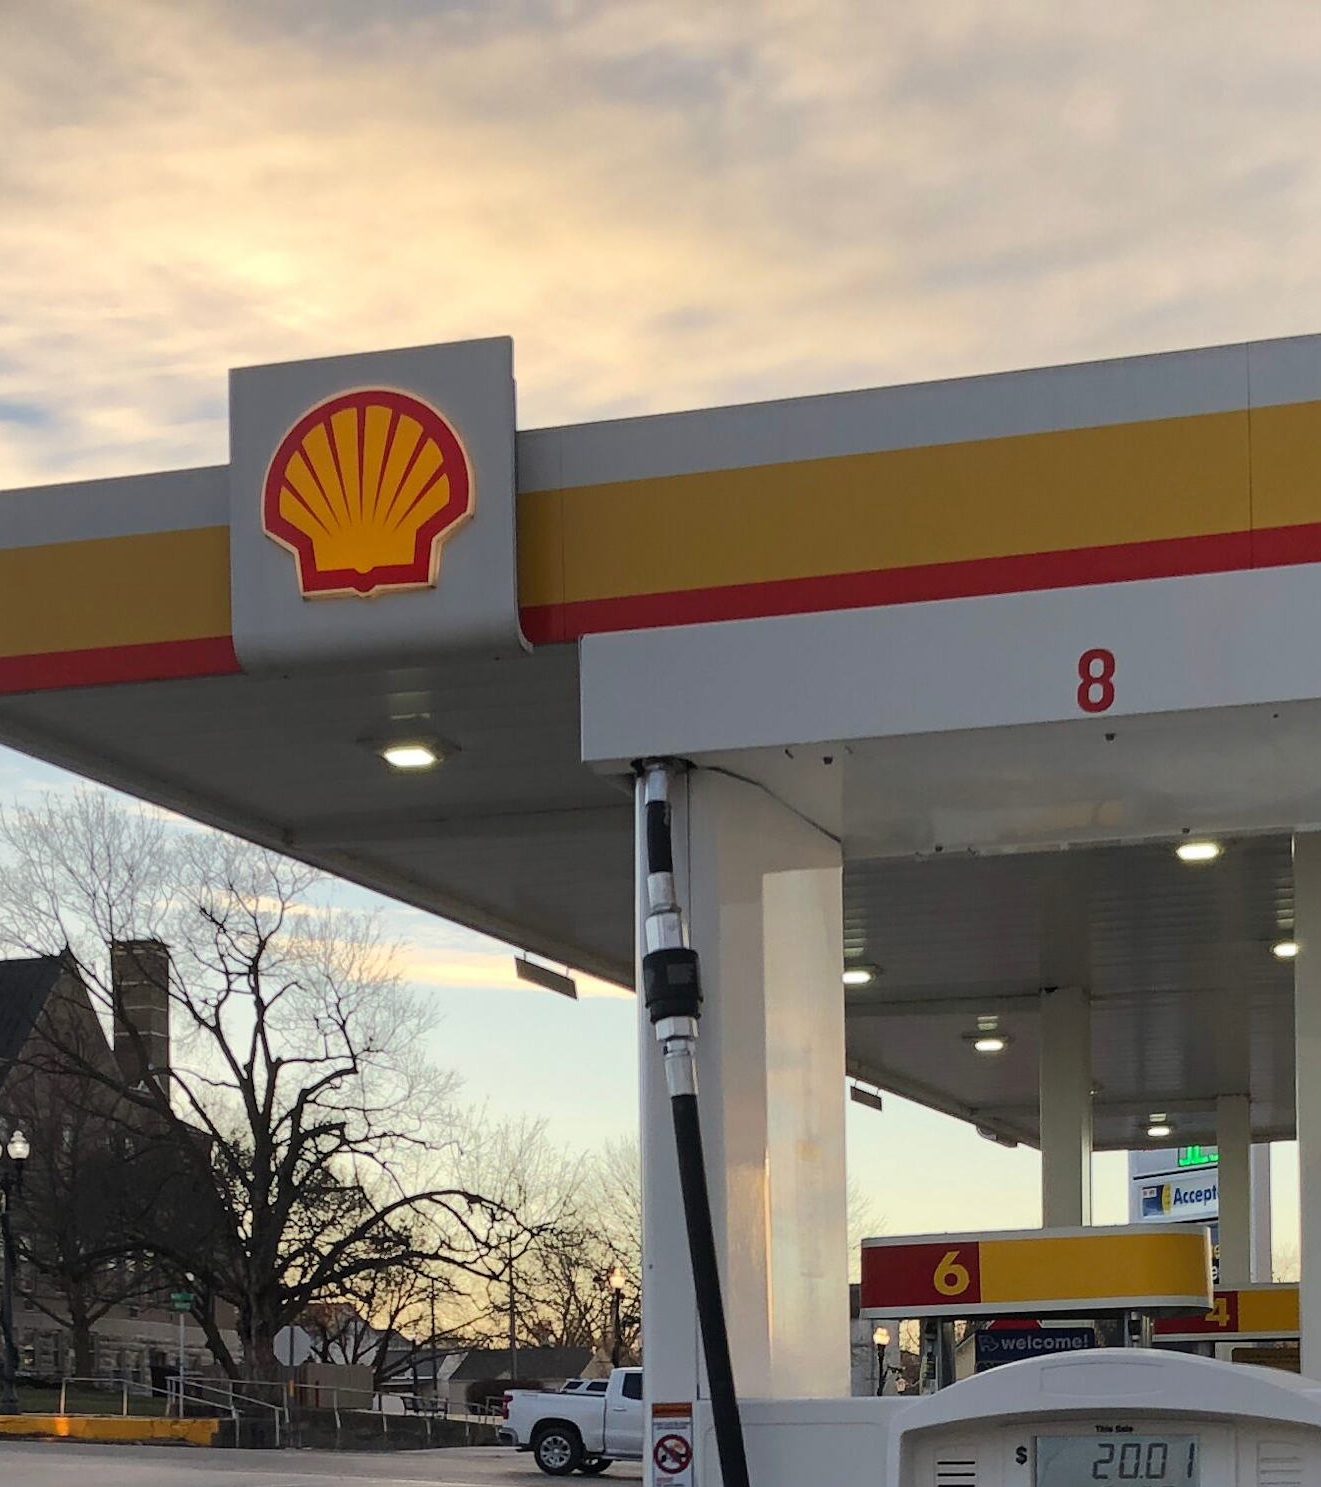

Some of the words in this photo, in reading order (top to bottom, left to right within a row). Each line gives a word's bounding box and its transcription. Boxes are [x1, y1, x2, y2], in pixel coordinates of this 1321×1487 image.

[1078, 648, 1115, 713] 8
[934, 1250, 970, 1296] 6
[1205, 1298, 1229, 1327] 4
[1001, 1334, 1089, 1350] welcome!
[1115, 1425, 1134, 1433] Sale
[1015, 1446, 1028, 1465] $
[1092, 1442, 1195, 1479] 20.01
